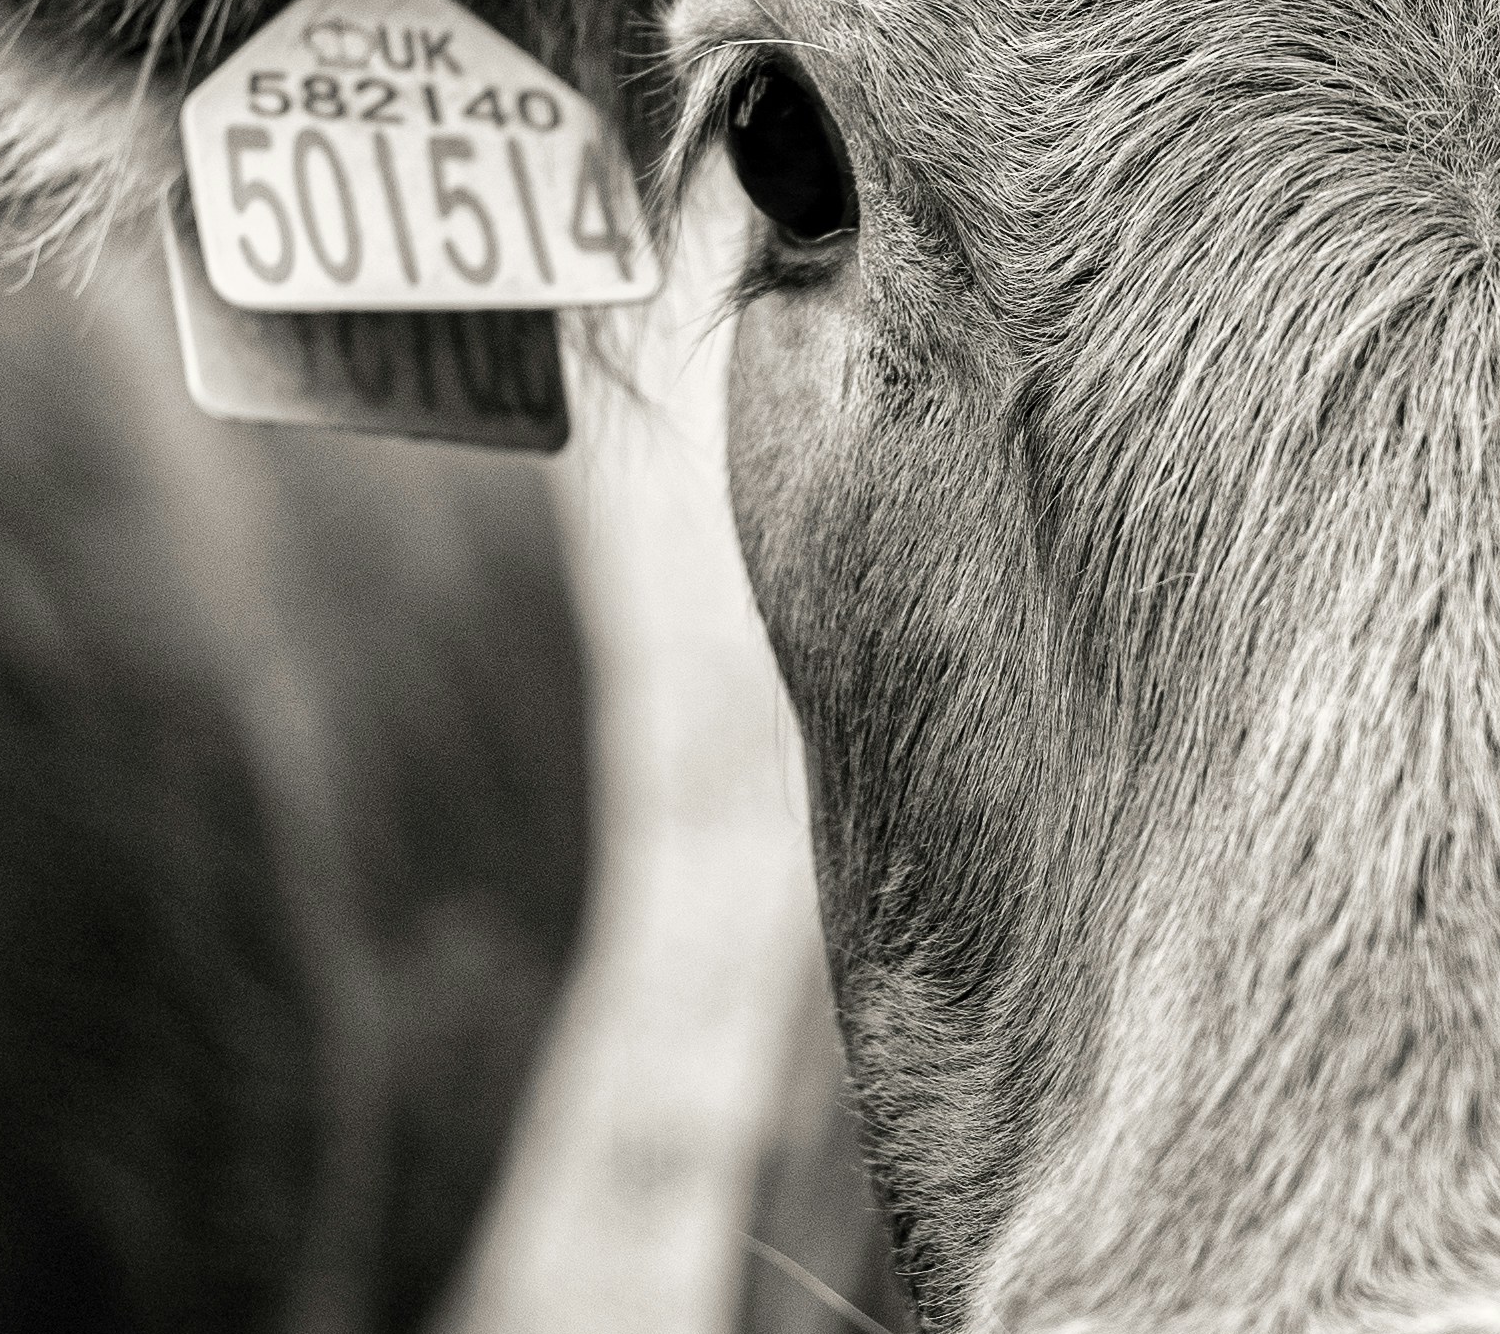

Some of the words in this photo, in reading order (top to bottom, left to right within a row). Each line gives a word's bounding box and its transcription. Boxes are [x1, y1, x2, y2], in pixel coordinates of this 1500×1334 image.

[376, 23, 460, 73] UK
[247, 71, 562, 133] 582140
[225, 124, 634, 286] 501514
